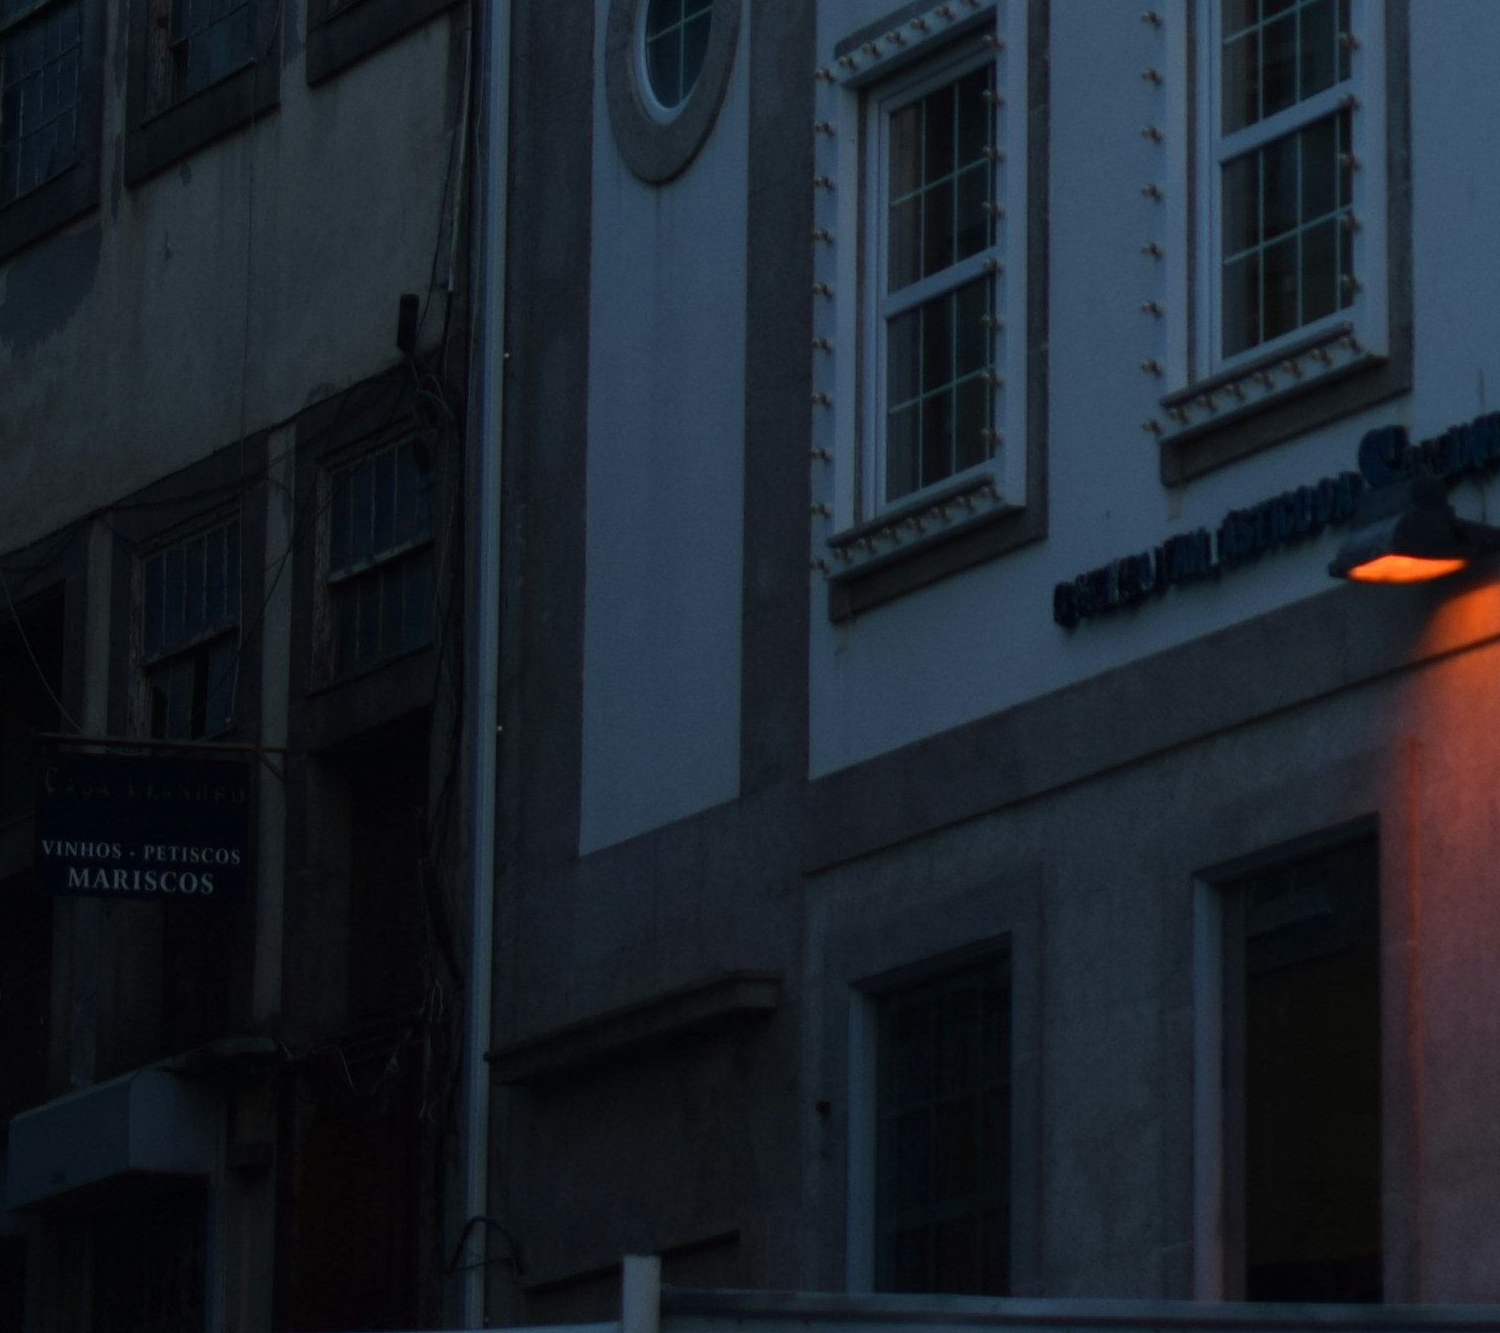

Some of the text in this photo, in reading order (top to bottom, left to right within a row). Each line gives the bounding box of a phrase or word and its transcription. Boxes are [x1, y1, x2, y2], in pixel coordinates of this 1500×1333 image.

[41, 839, 242, 866] VINHOS PETISCOS
[67, 865, 216, 895] MARISCOS
